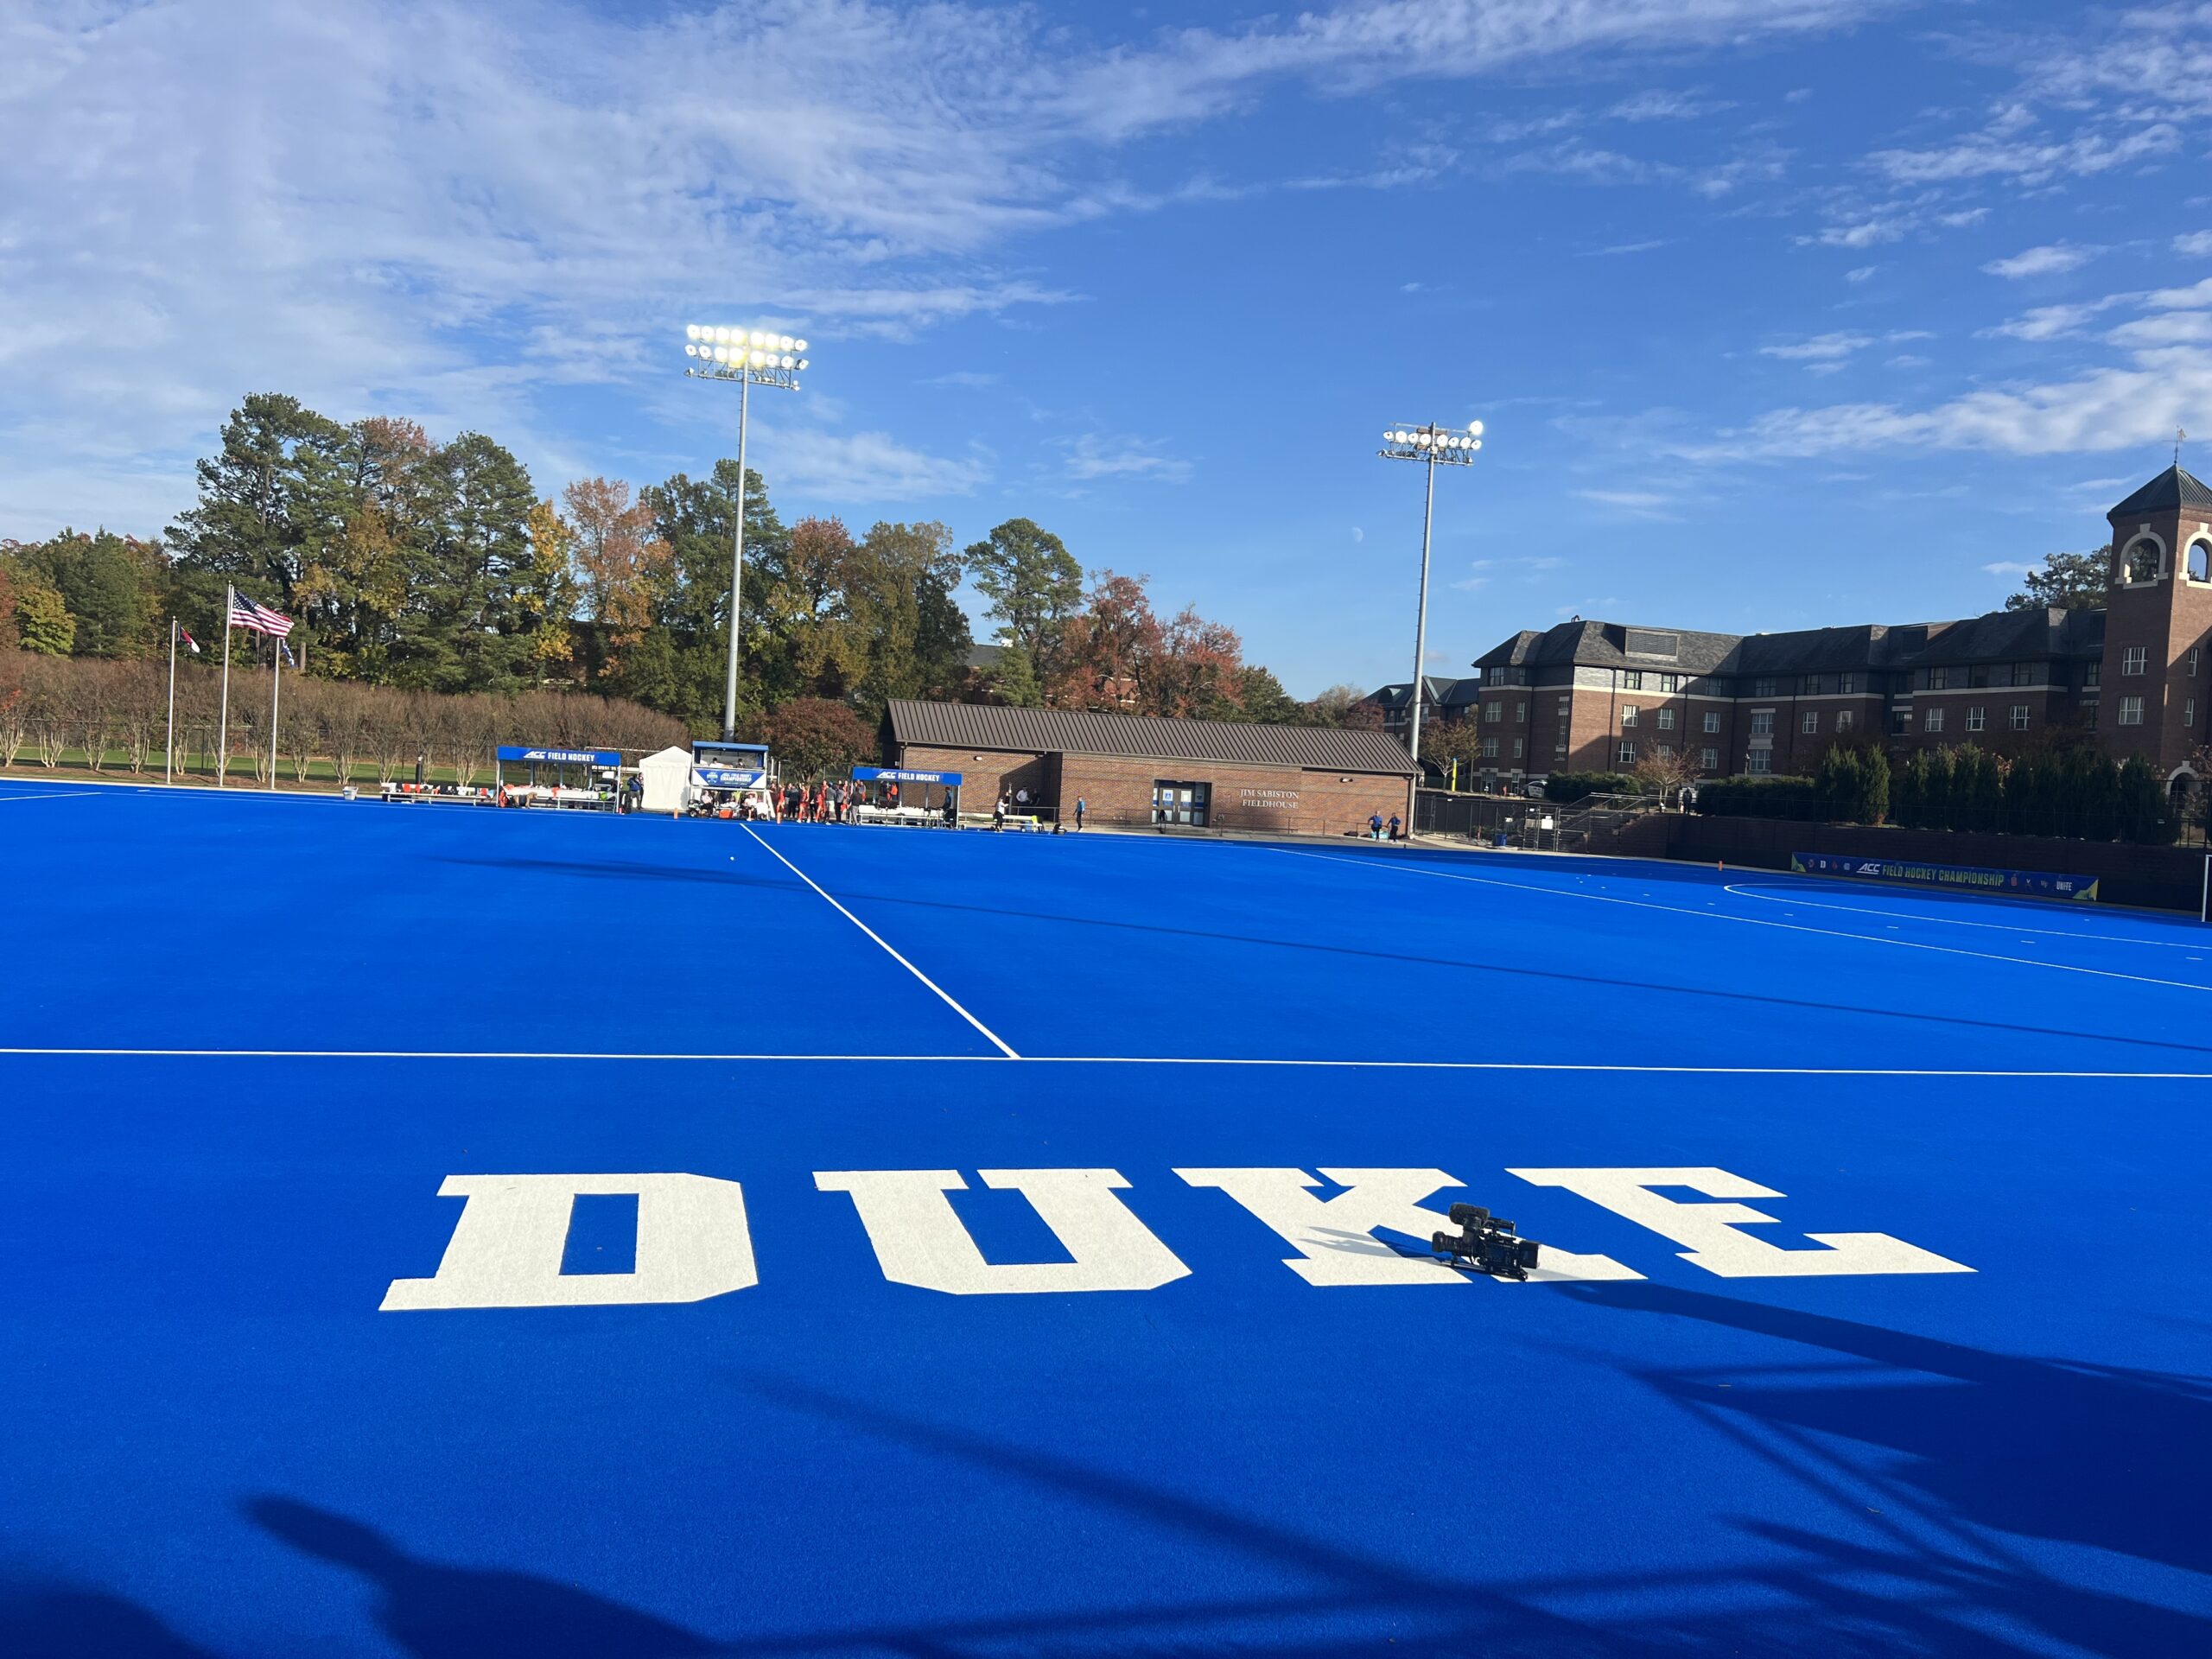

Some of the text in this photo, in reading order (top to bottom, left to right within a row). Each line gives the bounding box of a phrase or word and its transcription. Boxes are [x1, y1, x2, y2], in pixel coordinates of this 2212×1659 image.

[523, 751, 595, 762] ACC FIELD HOCKEY
[876, 771, 940, 782] ACC FIELD HOCKEY
[1240, 789, 1300, 799] JIM SABISTON
[1242, 799, 1300, 809] FIELDHOUSE
[1856, 862, 2005, 887] ACC FIELD HOCKEY CHAMPIONSHIP
[2056, 880, 2073, 892] UNITE
[379, 1167, 1978, 1311] DUKE
